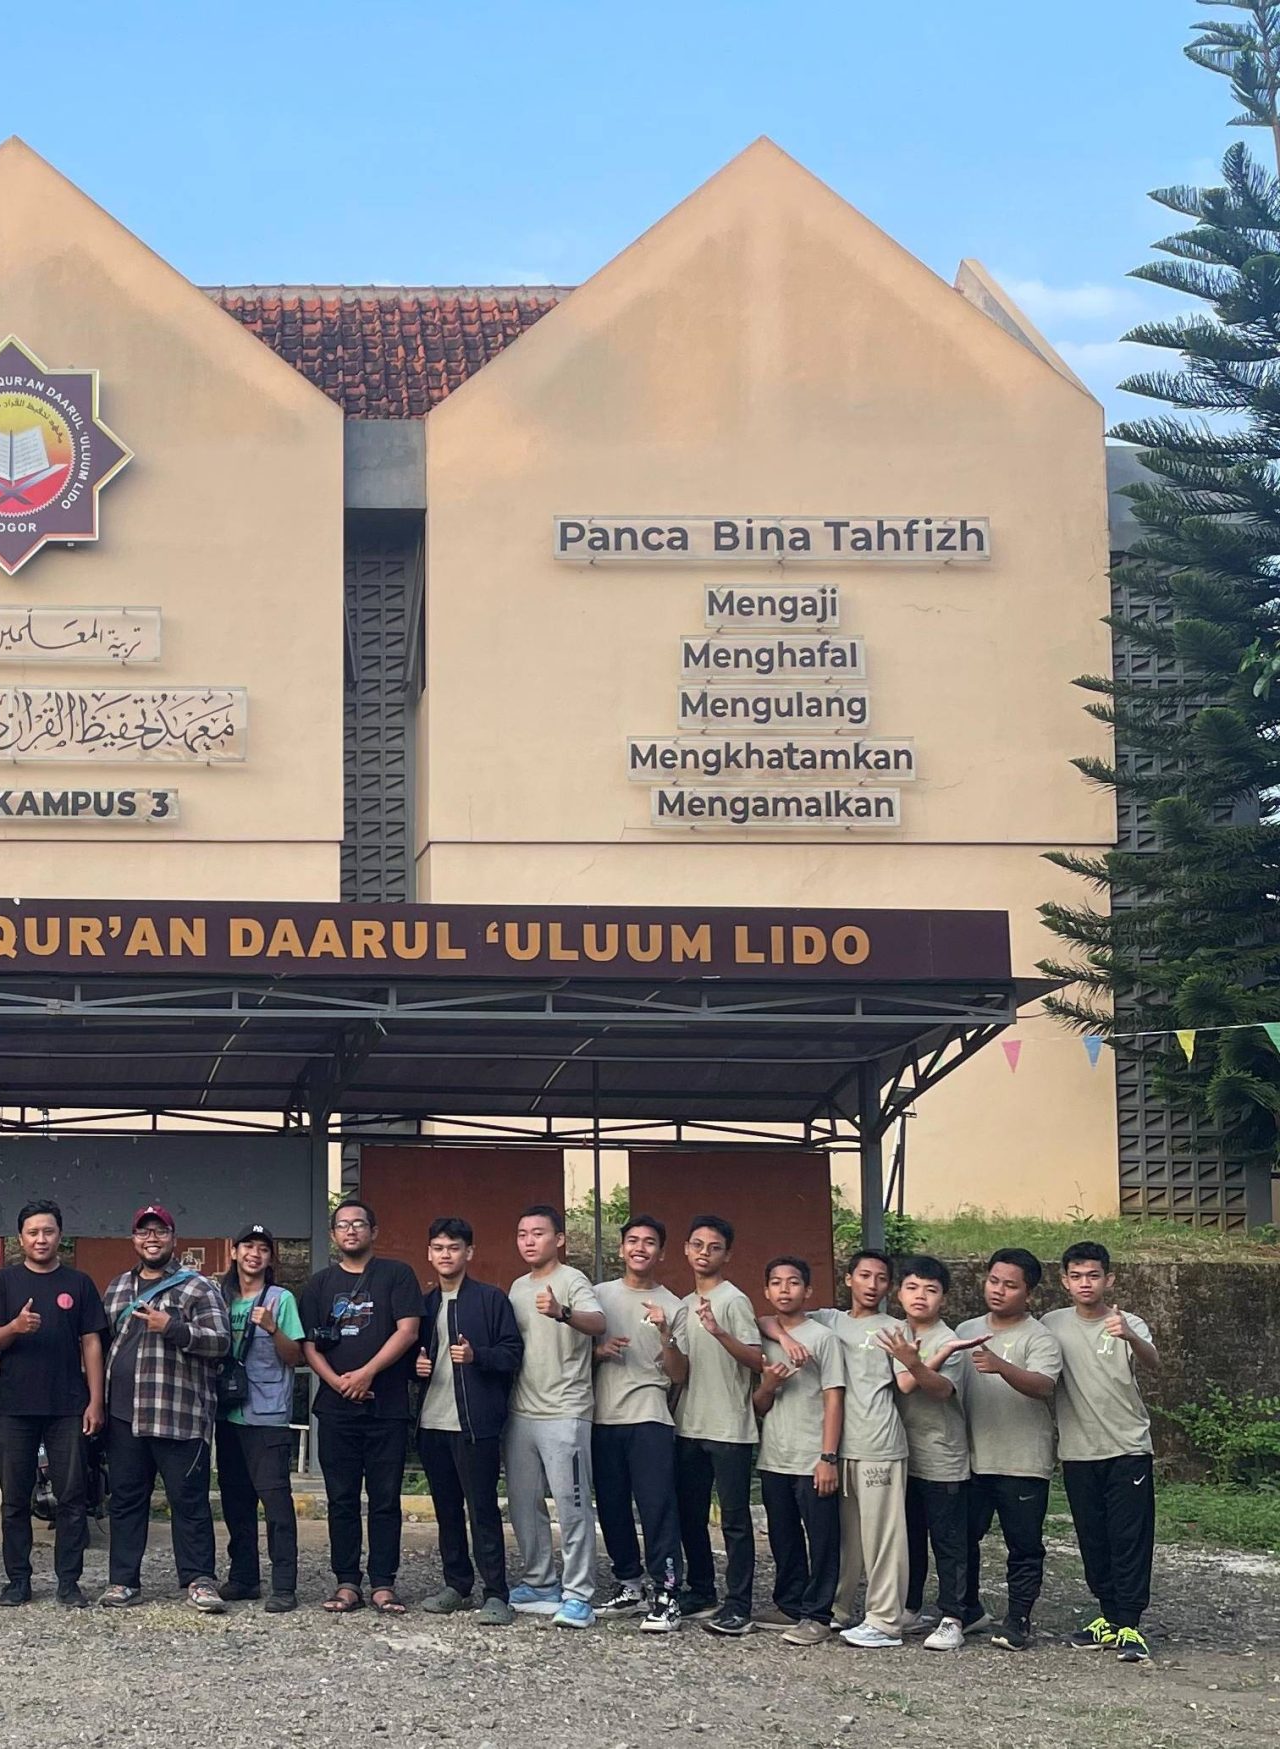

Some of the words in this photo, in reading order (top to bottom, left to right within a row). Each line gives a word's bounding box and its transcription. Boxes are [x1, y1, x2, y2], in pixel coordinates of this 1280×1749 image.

[46, 386, 85, 431] DAARUL
[61, 483, 84, 510] LIDO
[560, 522, 689, 551] Panca
[714, 519, 810, 551] Bina
[825, 519, 984, 552] Tahfizh
[708, 588, 837, 622] Mengaji
[684, 641, 857, 674] Menghafal
[681, 691, 866, 723] Mengulang
[631, 742, 912, 775] Mengkhatamkan
[151, 792, 169, 817] 3
[658, 790, 894, 824] Mengamalkan
[230, 918, 467, 960] DAARUL
[486, 922, 712, 962] 'ULUUM
[735, 926, 871, 965] LIDO
